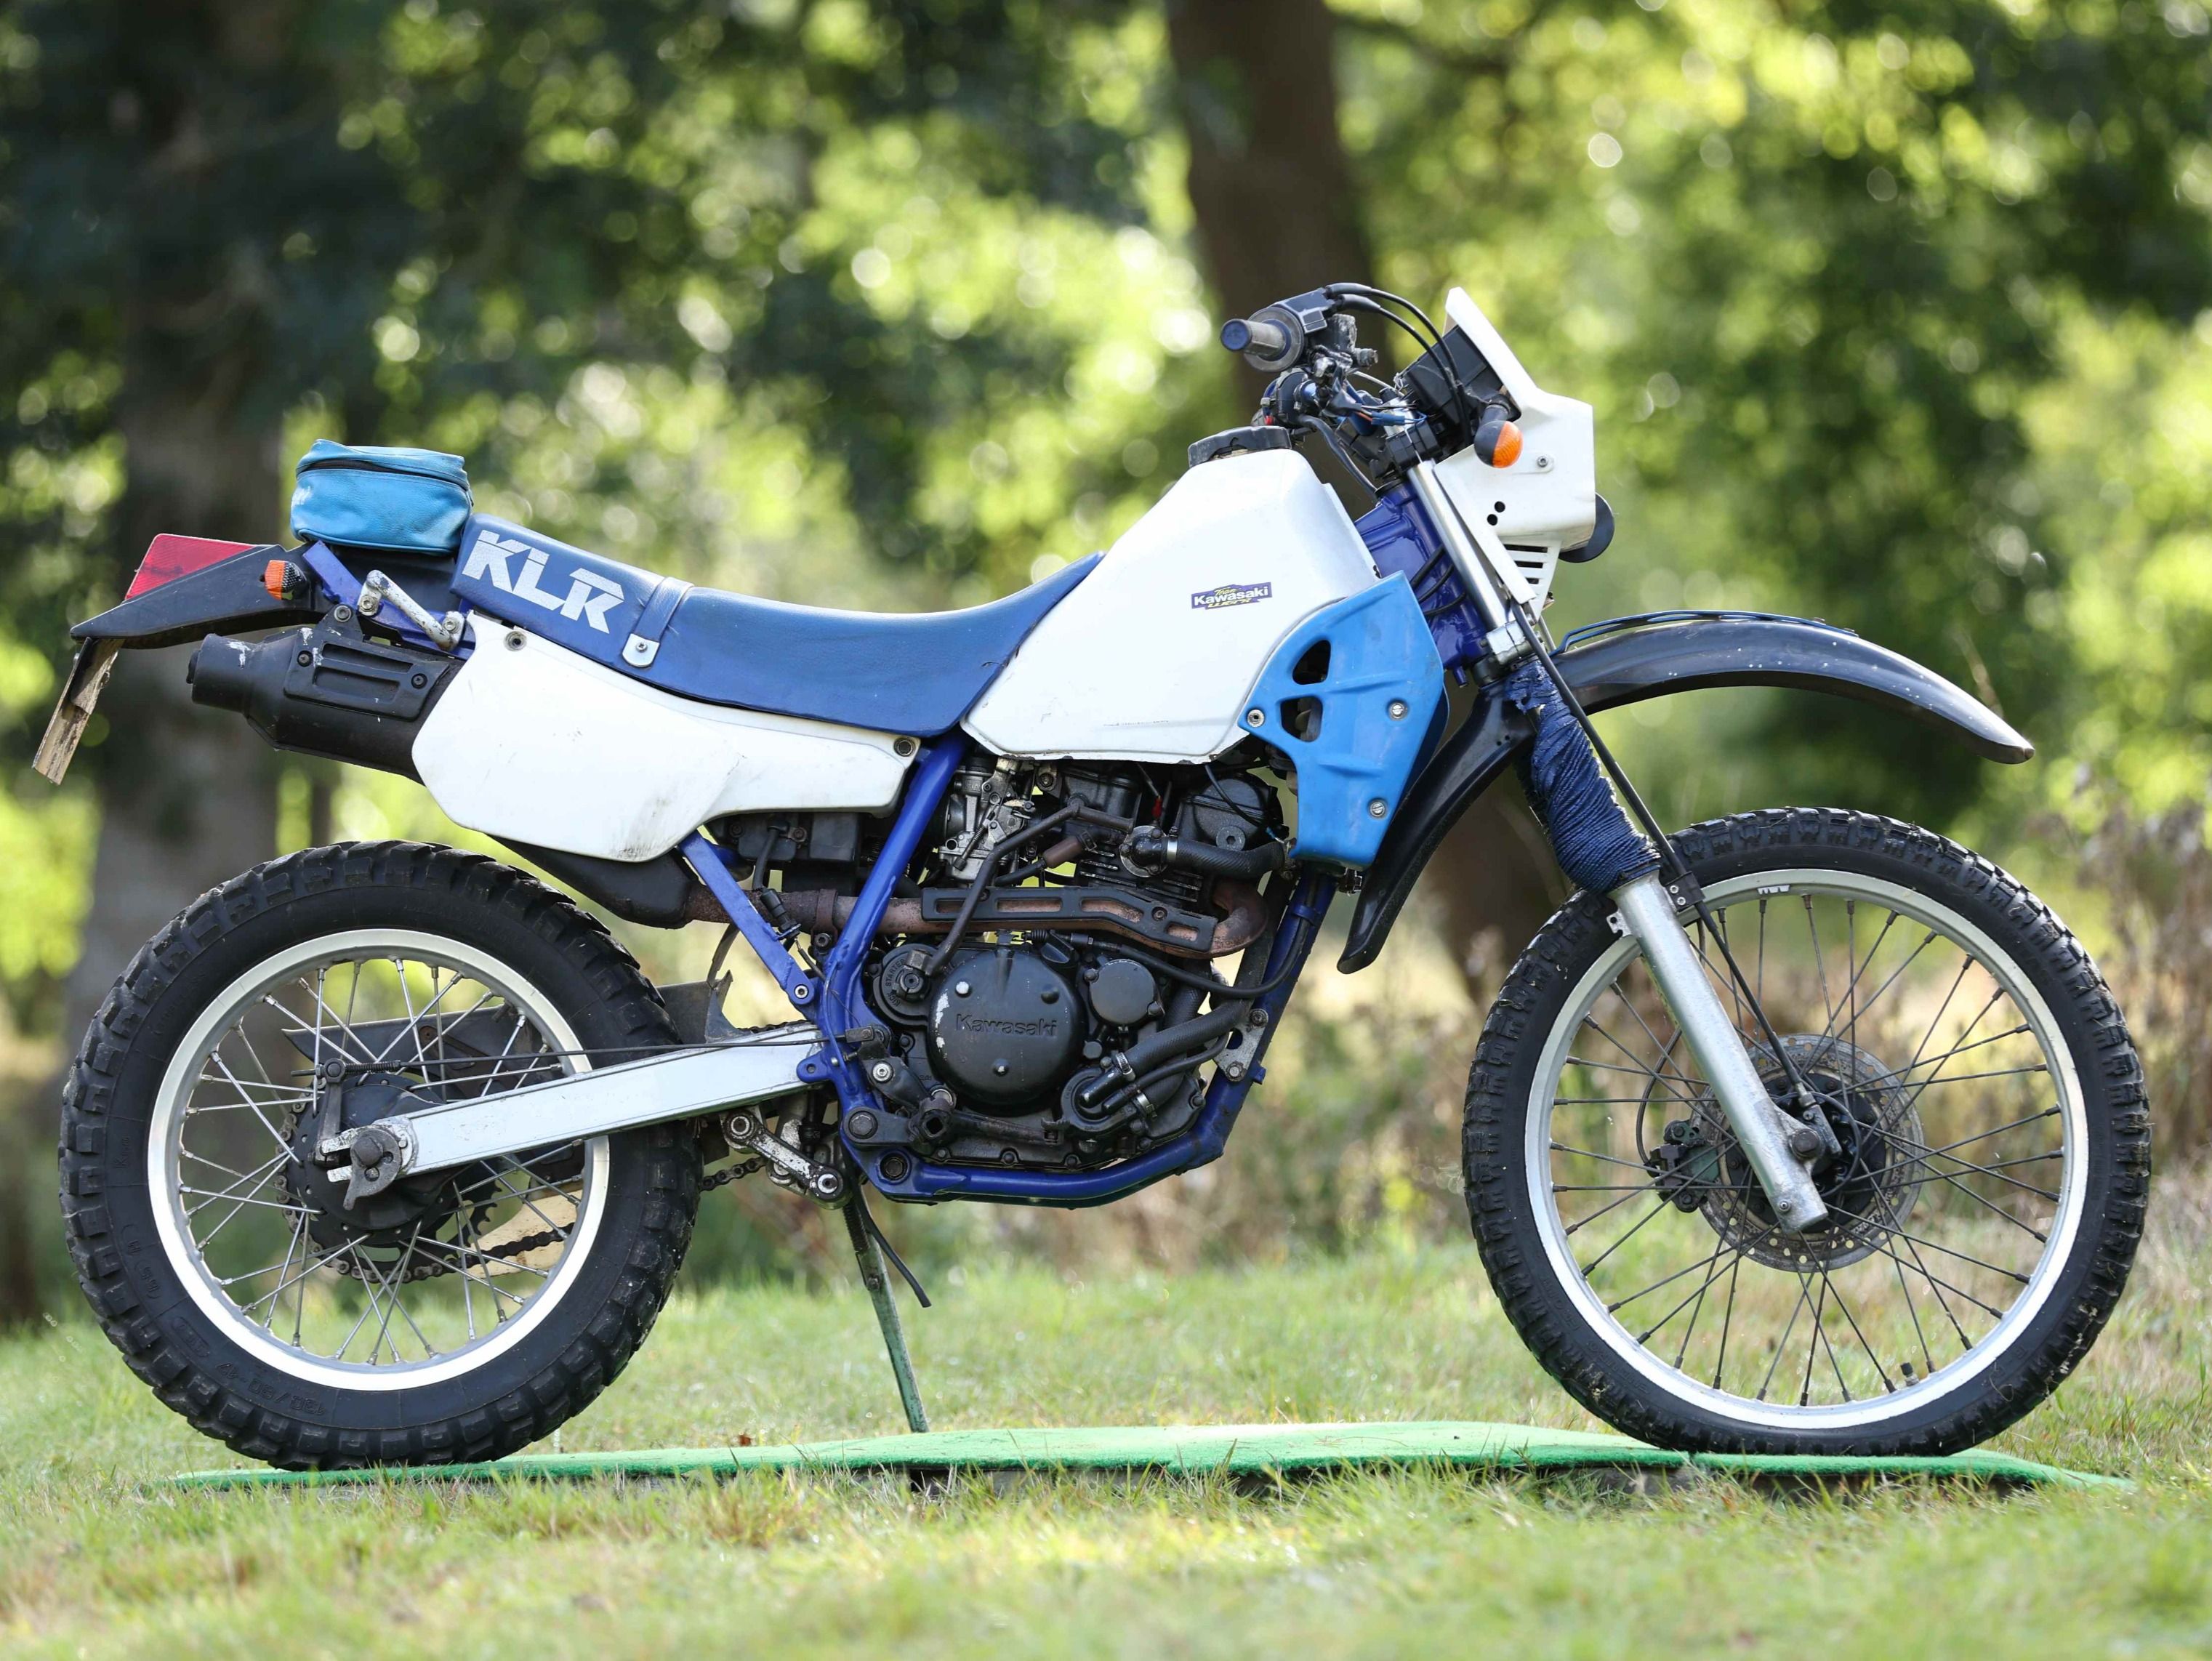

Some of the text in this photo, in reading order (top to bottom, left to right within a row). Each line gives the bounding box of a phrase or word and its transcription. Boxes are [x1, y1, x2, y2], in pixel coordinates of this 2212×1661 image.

[462, 529, 625, 635] KLR
[1194, 586, 1269, 606] Kawasaki
[887, 992, 901, 1008] KICK
[956, 1013, 1057, 1036] Kawasaki
